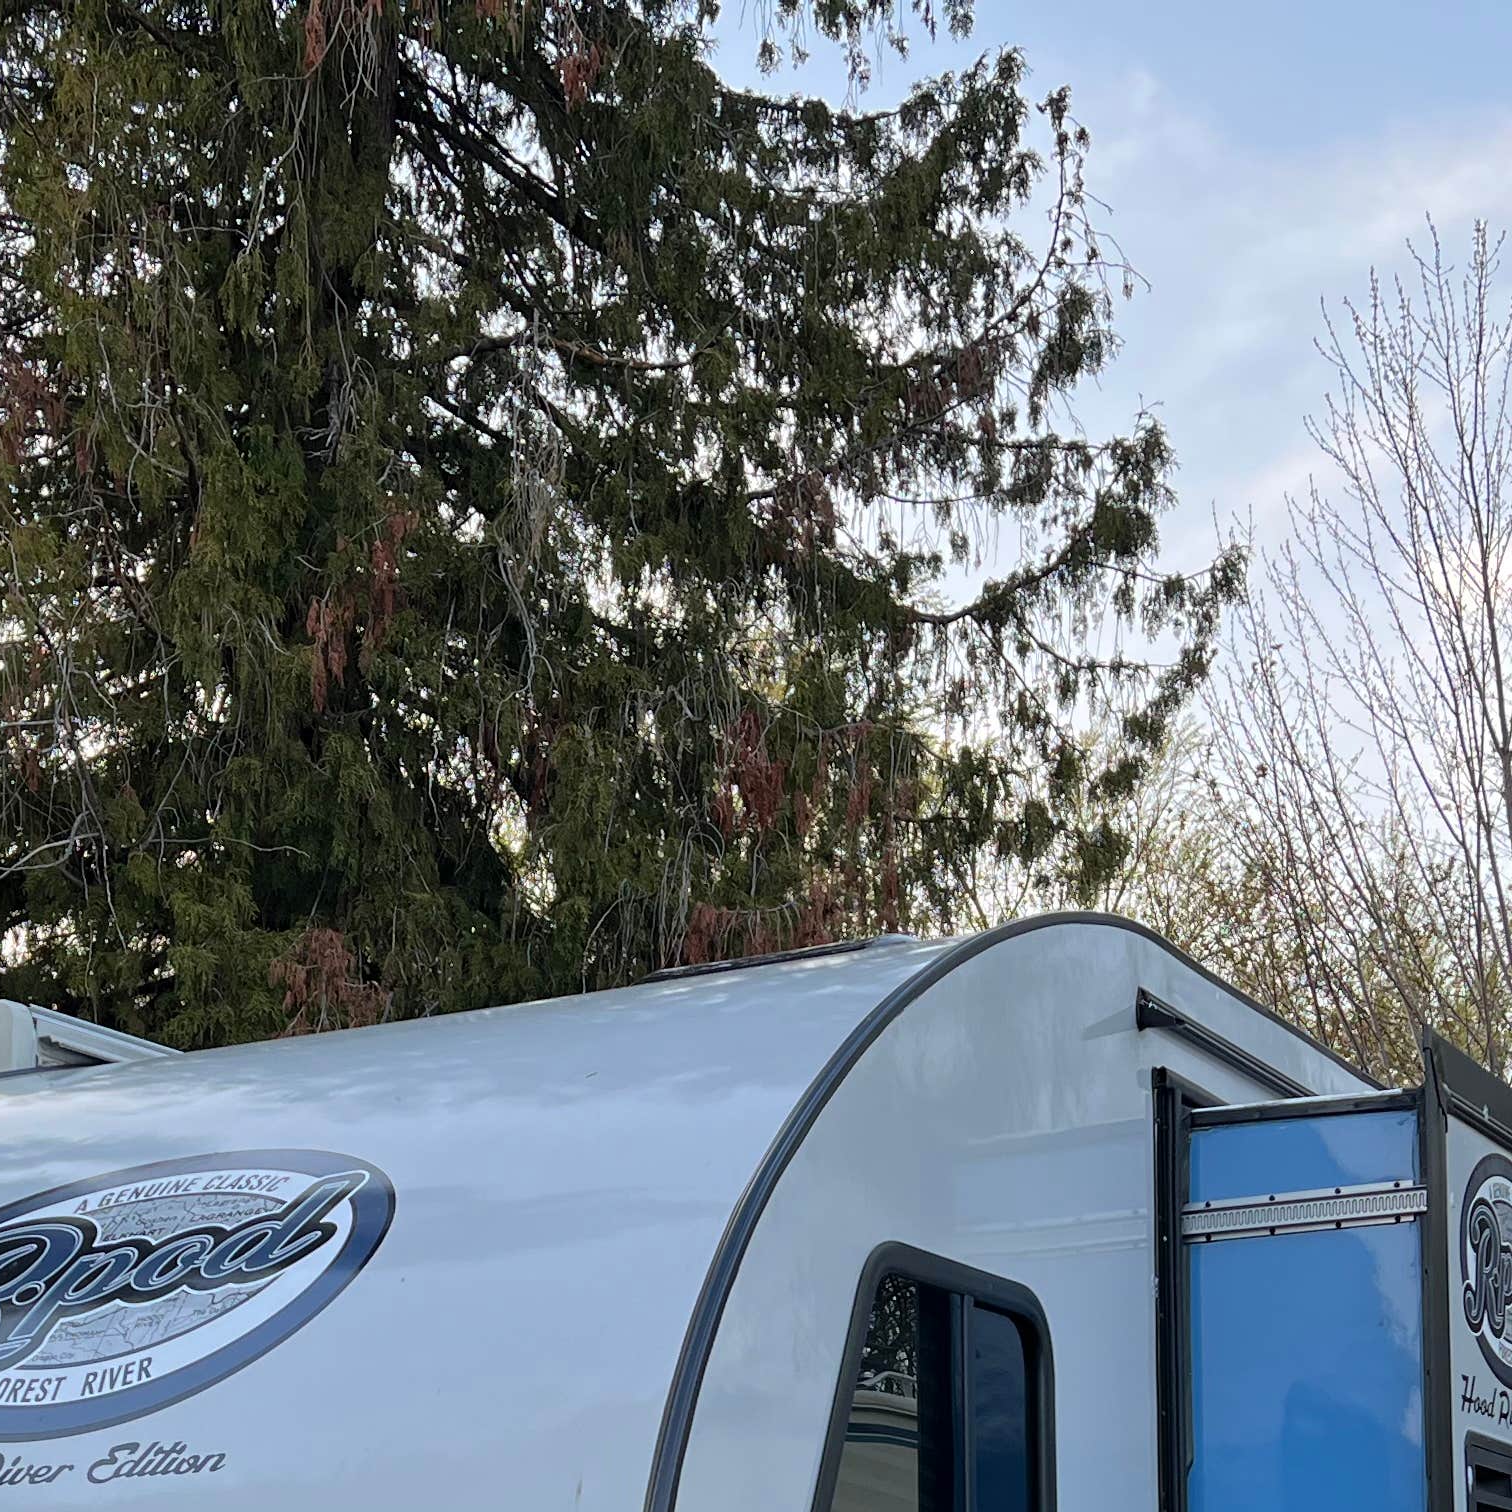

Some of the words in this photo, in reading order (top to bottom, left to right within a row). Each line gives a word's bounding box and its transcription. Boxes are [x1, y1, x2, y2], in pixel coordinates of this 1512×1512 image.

[73, 1201, 88, 1214] A
[97, 1176, 202, 1208] GENUINE
[202, 1174, 291, 1193] CLASSIC
[80, 1356, 153, 1397] RIVER
[1461, 1373, 1497, 1419] Hood
[87, 1440, 227, 1484] Edition
